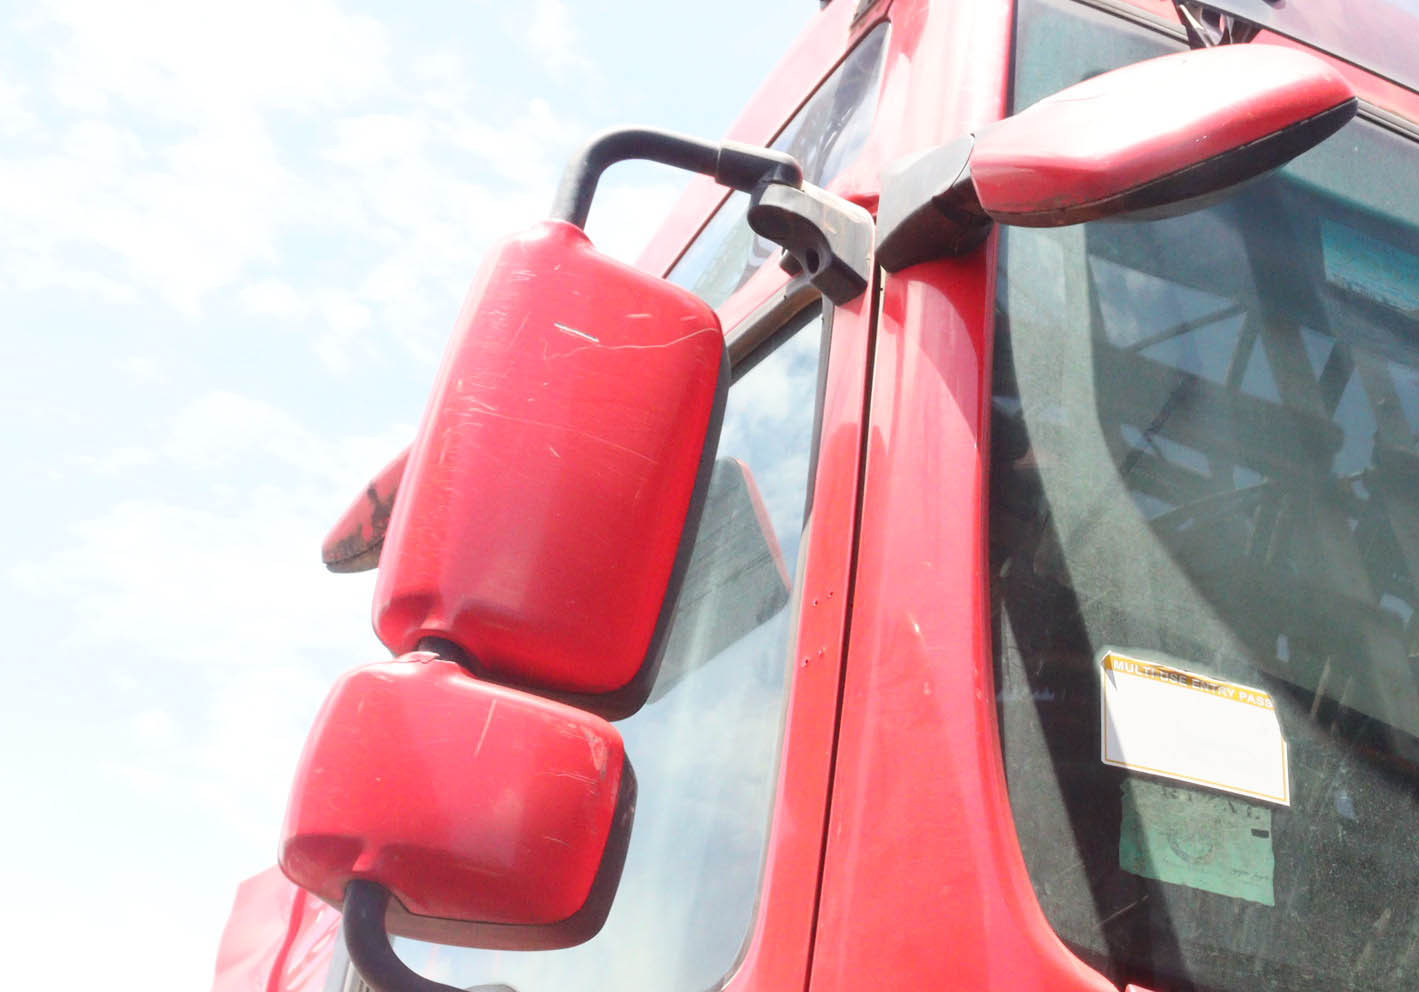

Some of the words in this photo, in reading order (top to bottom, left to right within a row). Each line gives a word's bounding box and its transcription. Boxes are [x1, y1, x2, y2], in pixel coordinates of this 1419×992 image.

[1113, 660, 1156, 678] MULTI
[1159, 669, 1187, 686] USE
[1191, 679, 1236, 698] ENTRY
[1238, 692, 1273, 708] PASS
